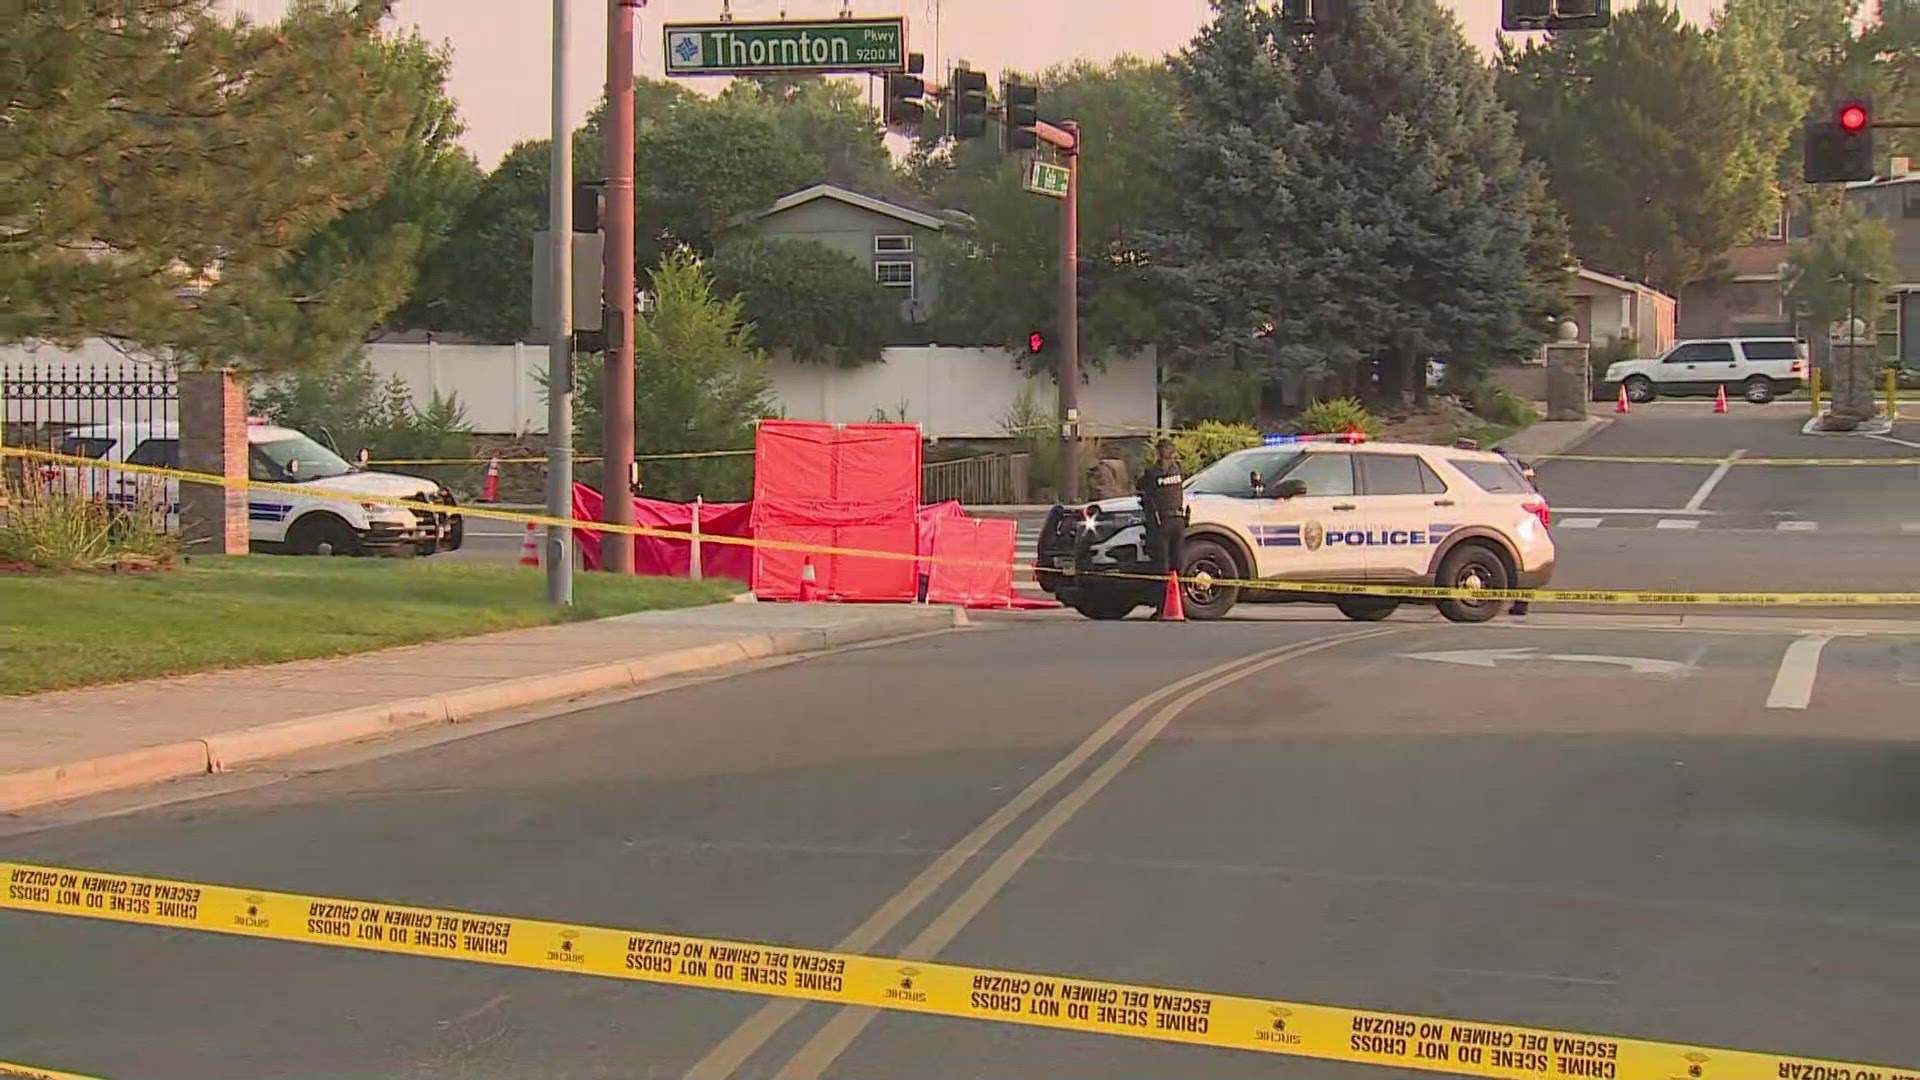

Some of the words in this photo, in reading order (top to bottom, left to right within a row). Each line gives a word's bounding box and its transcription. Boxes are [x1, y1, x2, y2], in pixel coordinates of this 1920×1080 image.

[864, 29, 895, 42] Pkwy
[711, 31, 849, 65] Thornton
[856, 49, 885, 61] 9200
[888, 48, 896, 59] N
[1325, 530, 1426, 546] POLICE
[11, 868, 56, 886] CRUZAR
[60, 874, 77, 889] NO
[81, 876, 127, 894] CRIMEN
[9, 884, 49, 904] CROSS
[56, 889, 80, 907] NOT
[130, 881, 151, 897] DEL
[155, 884, 200, 902] ESCENA
[86, 892, 103, 909] DO
[110, 895, 149, 914] SCENE
[157, 900, 196, 920] CRIME
[309, 902, 358, 921] CRUZAR
[361, 907, 379, 923] NO
[384, 910, 432, 929] CRIMEN
[307, 918, 350, 937] CROSS
[357, 923, 382, 941] NOT
[436, 915, 458, 932] DEL
[462, 918, 510, 937] ESCENA
[389, 926, 407, 944] DO
[414, 929, 456, 949] SCENE
[463, 935, 507, 955] CRIME
[628, 936, 680, 956] CRUZAR
[684, 943, 703, 959] NO
[626, 954, 671, 973] CROSS
[709, 945, 760, 965] CRIMEN
[764, 952, 788, 968] DEL
[793, 955, 845, 974] ESCENA
[679, 959, 707, 977] NOT
[714, 963, 733, 980] DO
[741, 966, 787, 986] SCENE
[795, 972, 842, 992] CRIME
[972, 974, 1030, 995] CRUZAR
[1034, 981, 1055, 998] NO
[970, 992, 1020, 1014] CROSS
[1061, 984, 1117, 1005] CRIMEN
[1122, 990, 1148, 1008] DEL
[1029, 998, 1059, 1018] NOT
[1067, 1002, 1088, 1021] DO
[1153, 994, 1210, 1015] ESCENA
[1097, 1005, 1147, 1027] SCENE
[1156, 1012, 1208, 1034] CRIME
[1352, 1016, 1415, 1038] CRUZAR
[1420, 1023, 1443, 1041] NO
[1351, 1034, 1406, 1057] CROSS
[1450, 1026, 1513, 1048] CRIMEN
[1519, 1033, 1548, 1052] DEL
[1414, 1040, 1449, 1061] NOT
[1458, 1045, 1481, 1065] DO
[1553, 1037, 1618, 1059] ESCENA
[1491, 1049, 1547, 1072] SCENE
[1557, 1055, 1615, 1079] CRIME
[1778, 1062, 1850, 1080] CRUZAR
